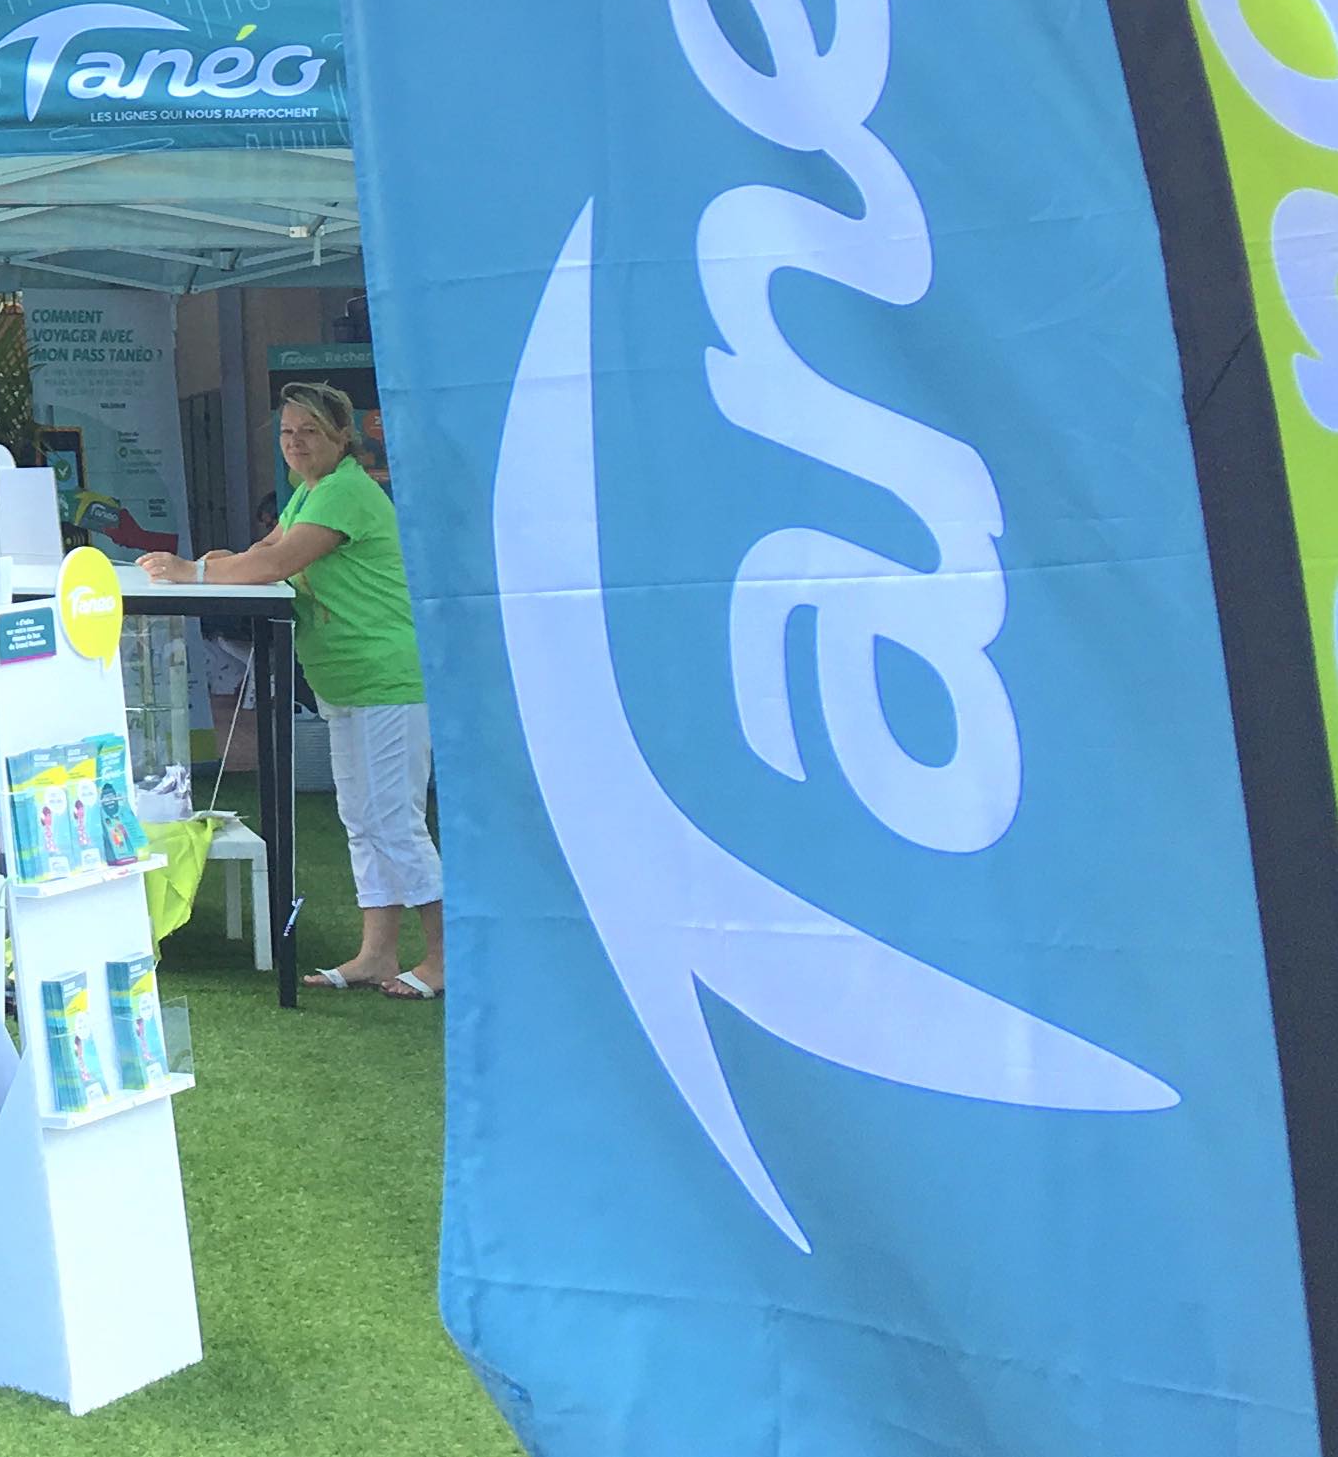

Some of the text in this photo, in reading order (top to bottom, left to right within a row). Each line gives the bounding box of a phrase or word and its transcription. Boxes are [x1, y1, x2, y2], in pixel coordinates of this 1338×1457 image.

[91, 107, 318, 122] LES LIGNES QUI NOUS RAPPROCHENT
[32, 309, 103, 323] COMMENT
[33, 328, 134, 343] VOYAGER AVEC
[34, 348, 68, 361] MON
[72, 348, 105, 362] PASS
[324, 351, 371, 362] Rechar
